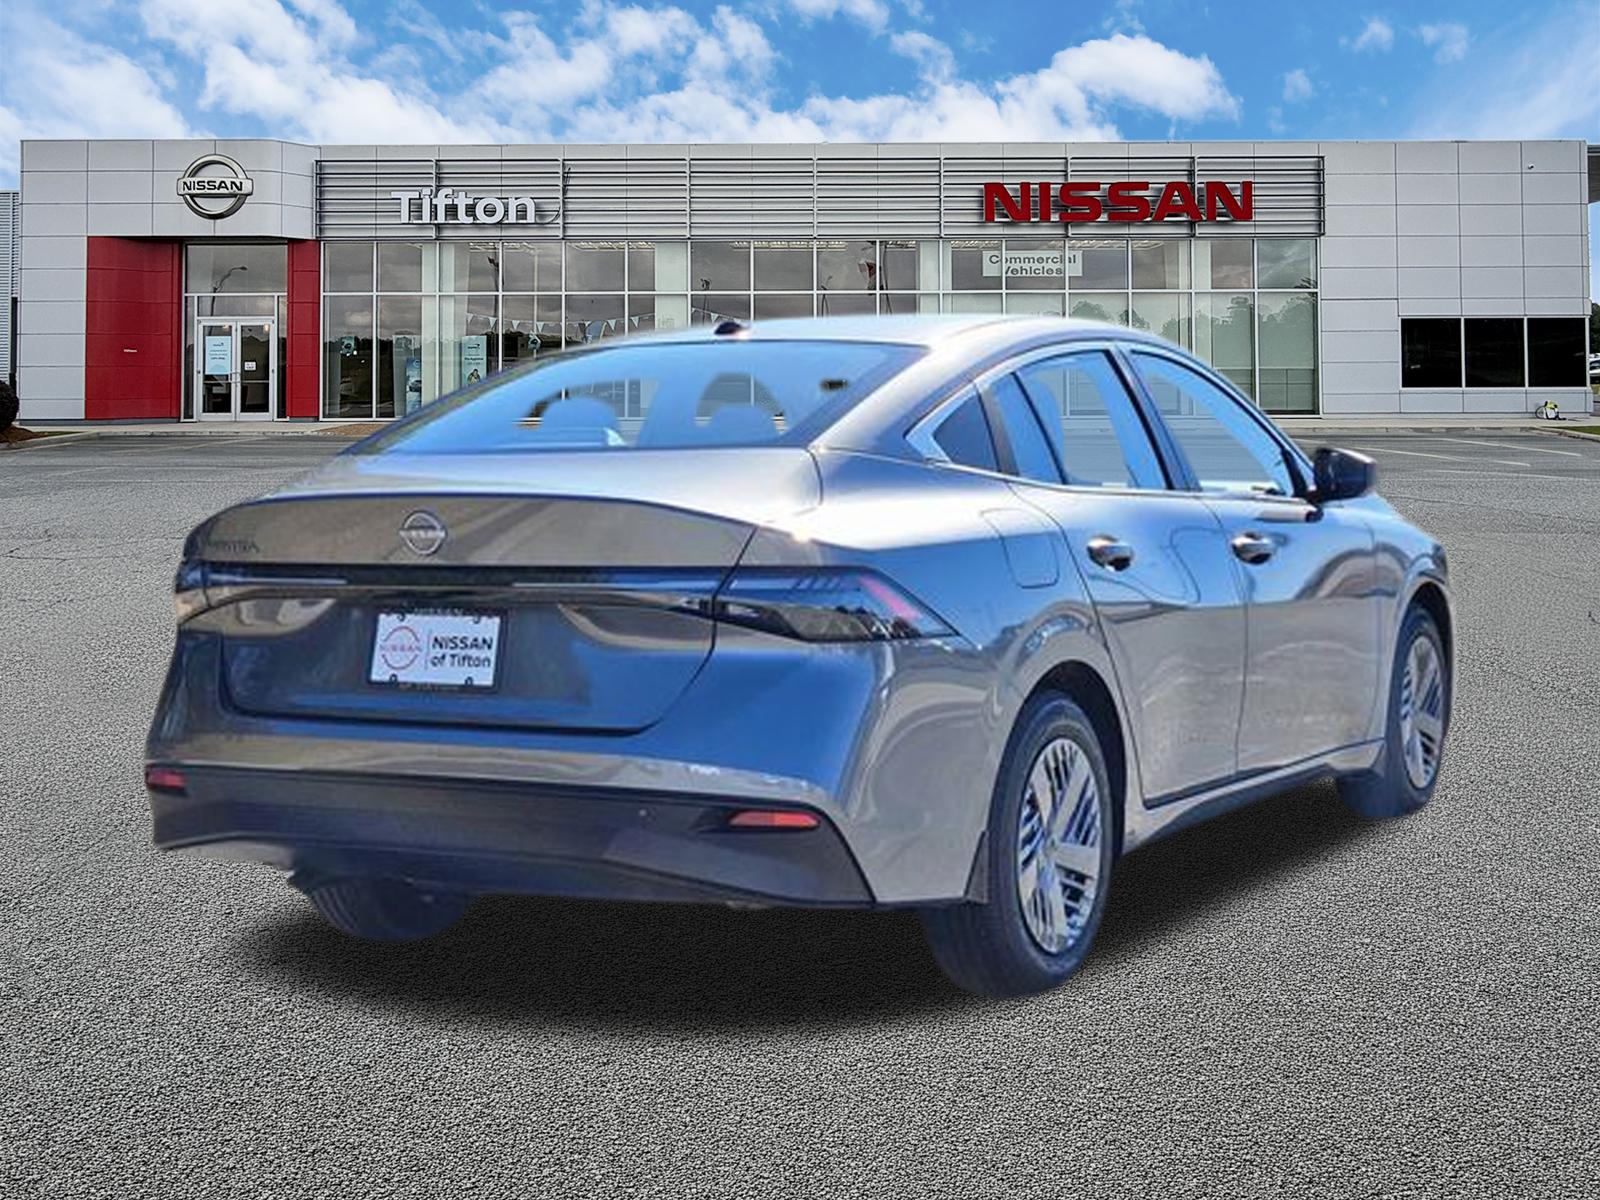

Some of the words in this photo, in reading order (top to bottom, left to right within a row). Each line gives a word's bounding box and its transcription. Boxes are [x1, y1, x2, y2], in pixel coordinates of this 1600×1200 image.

[183, 180, 243, 191] NISSAN
[391, 188, 536, 224] Tifton
[984, 181, 1253, 222] NISSAN
[432, 636, 493, 650] NISSAN
[431, 654, 446, 667] of
[449, 653, 491, 668] Tifton
